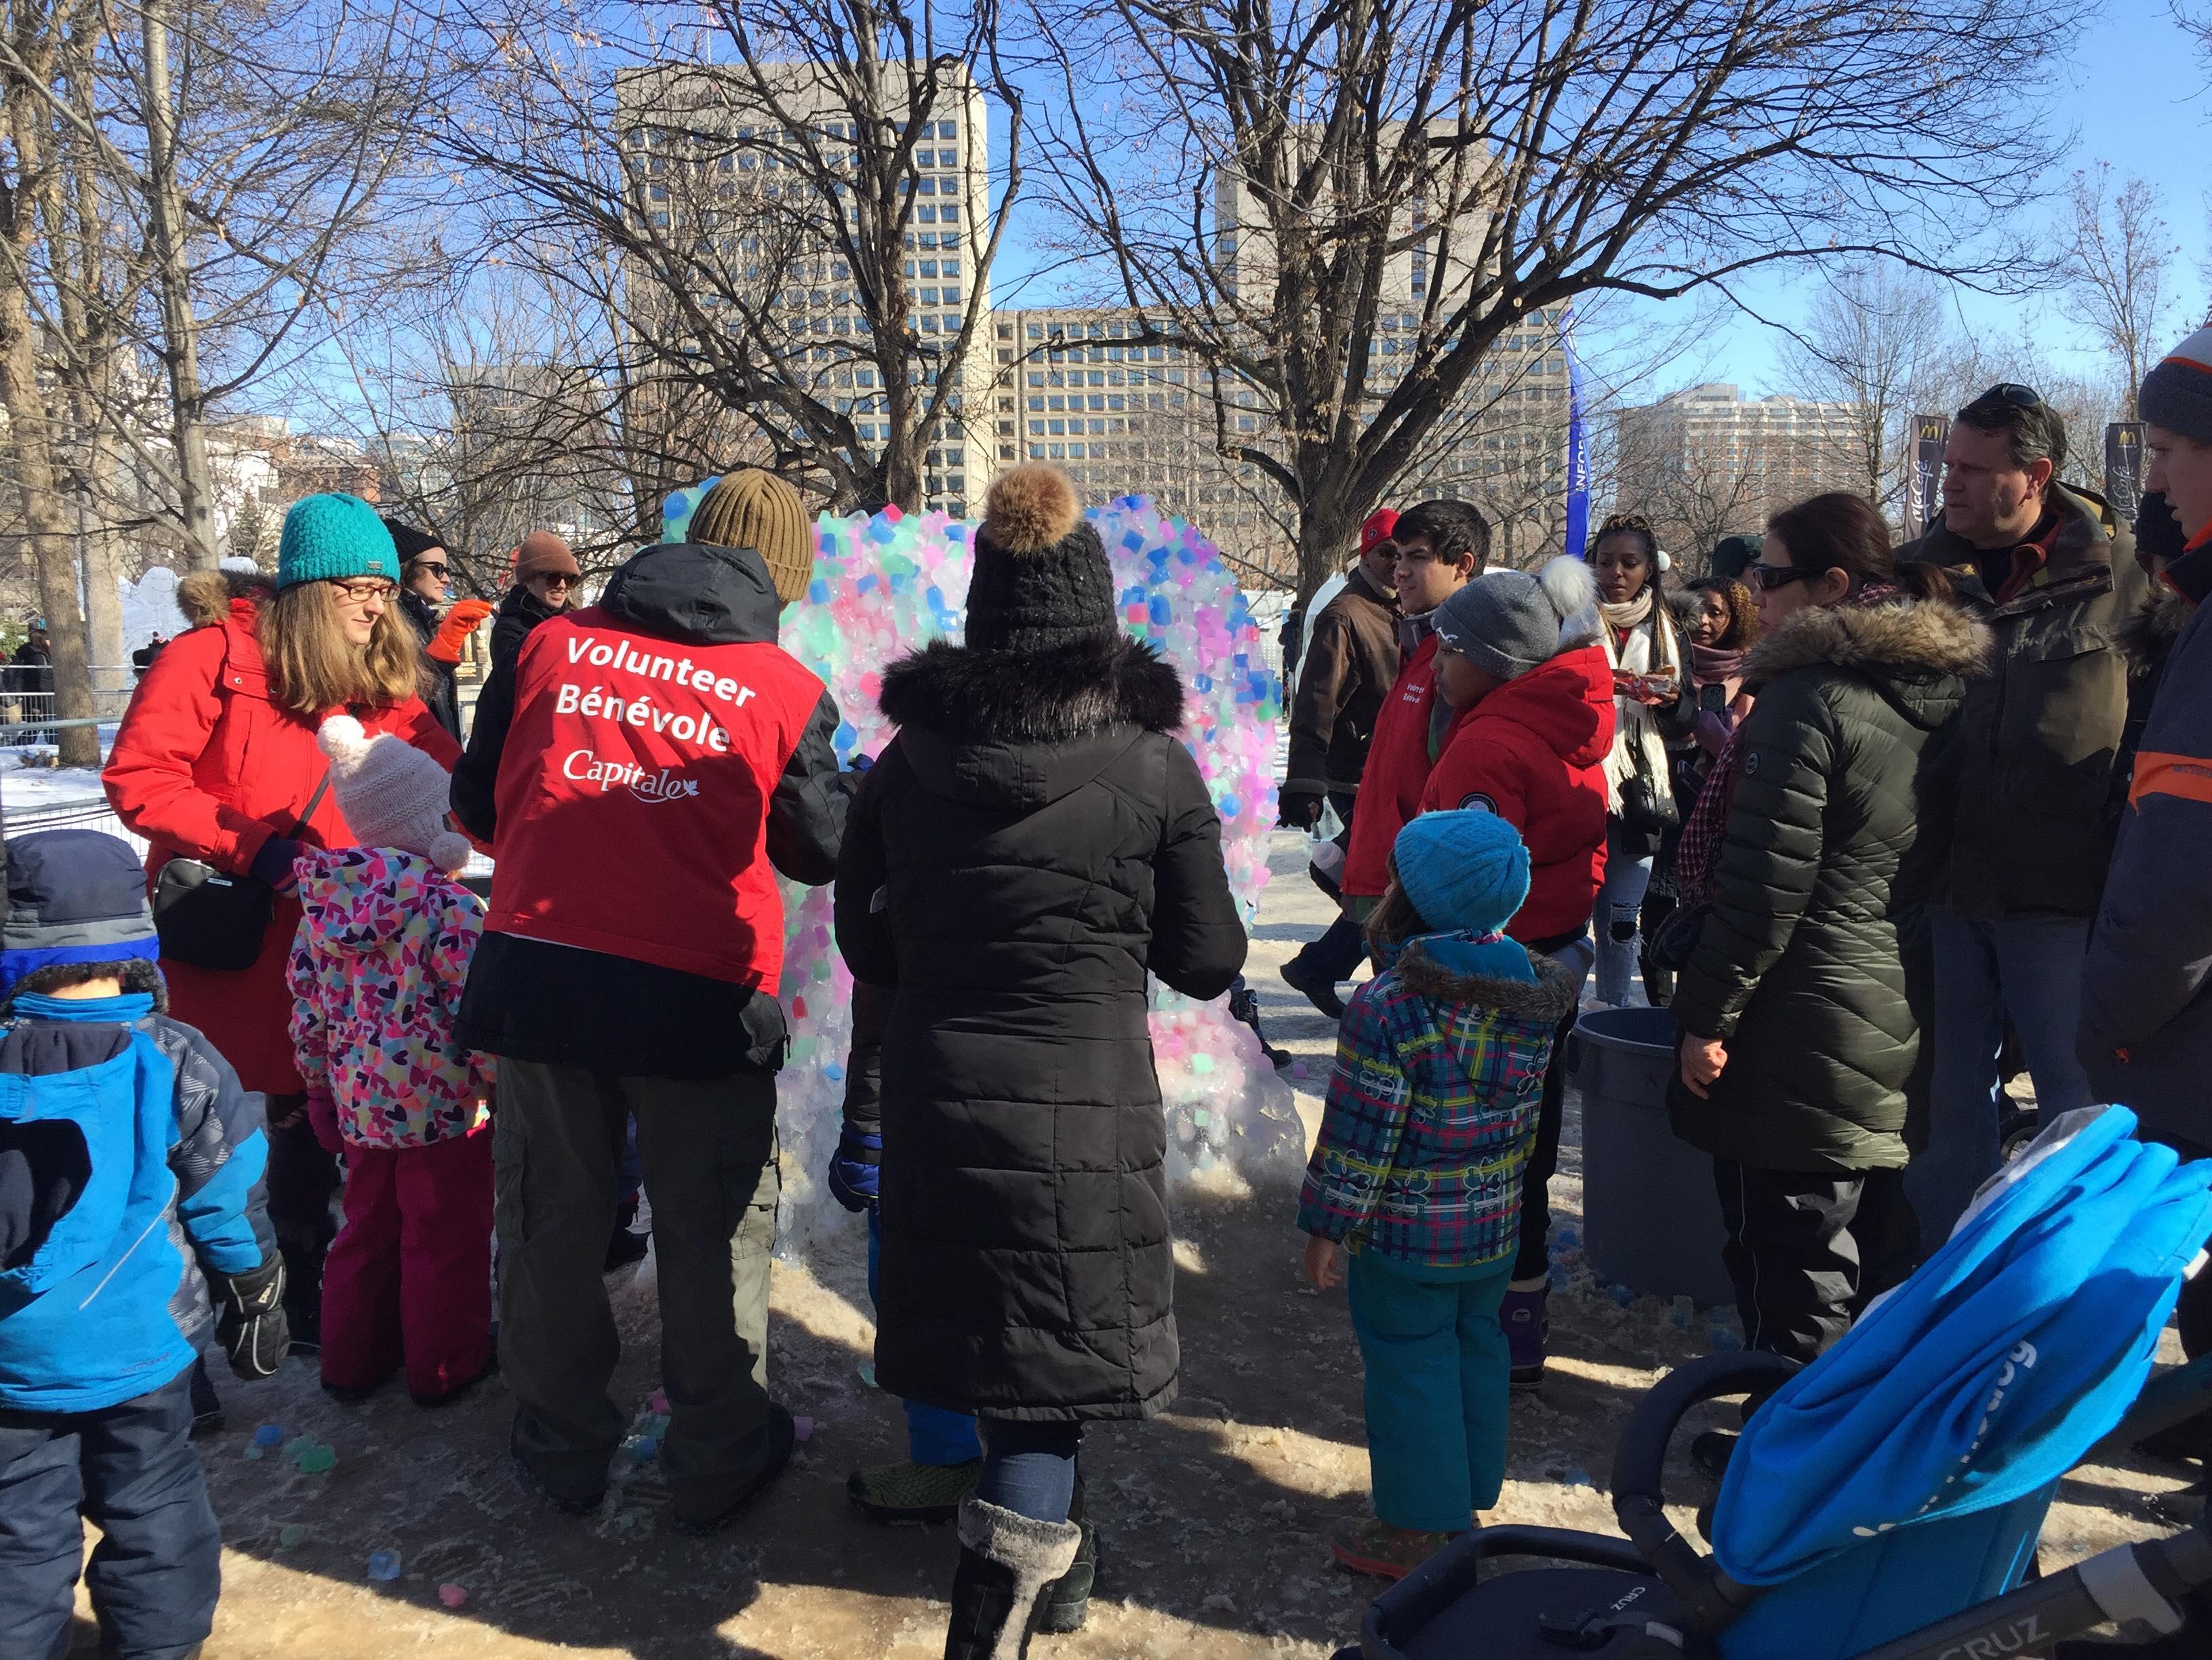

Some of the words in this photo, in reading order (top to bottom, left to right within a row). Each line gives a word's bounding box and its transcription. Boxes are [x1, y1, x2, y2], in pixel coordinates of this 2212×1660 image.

[568, 637, 757, 708] Volunteer
[556, 684, 730, 752] Bénévole
[563, 749, 687, 803] Capitale
[1610, 1587, 1646, 1611] CRUZ
